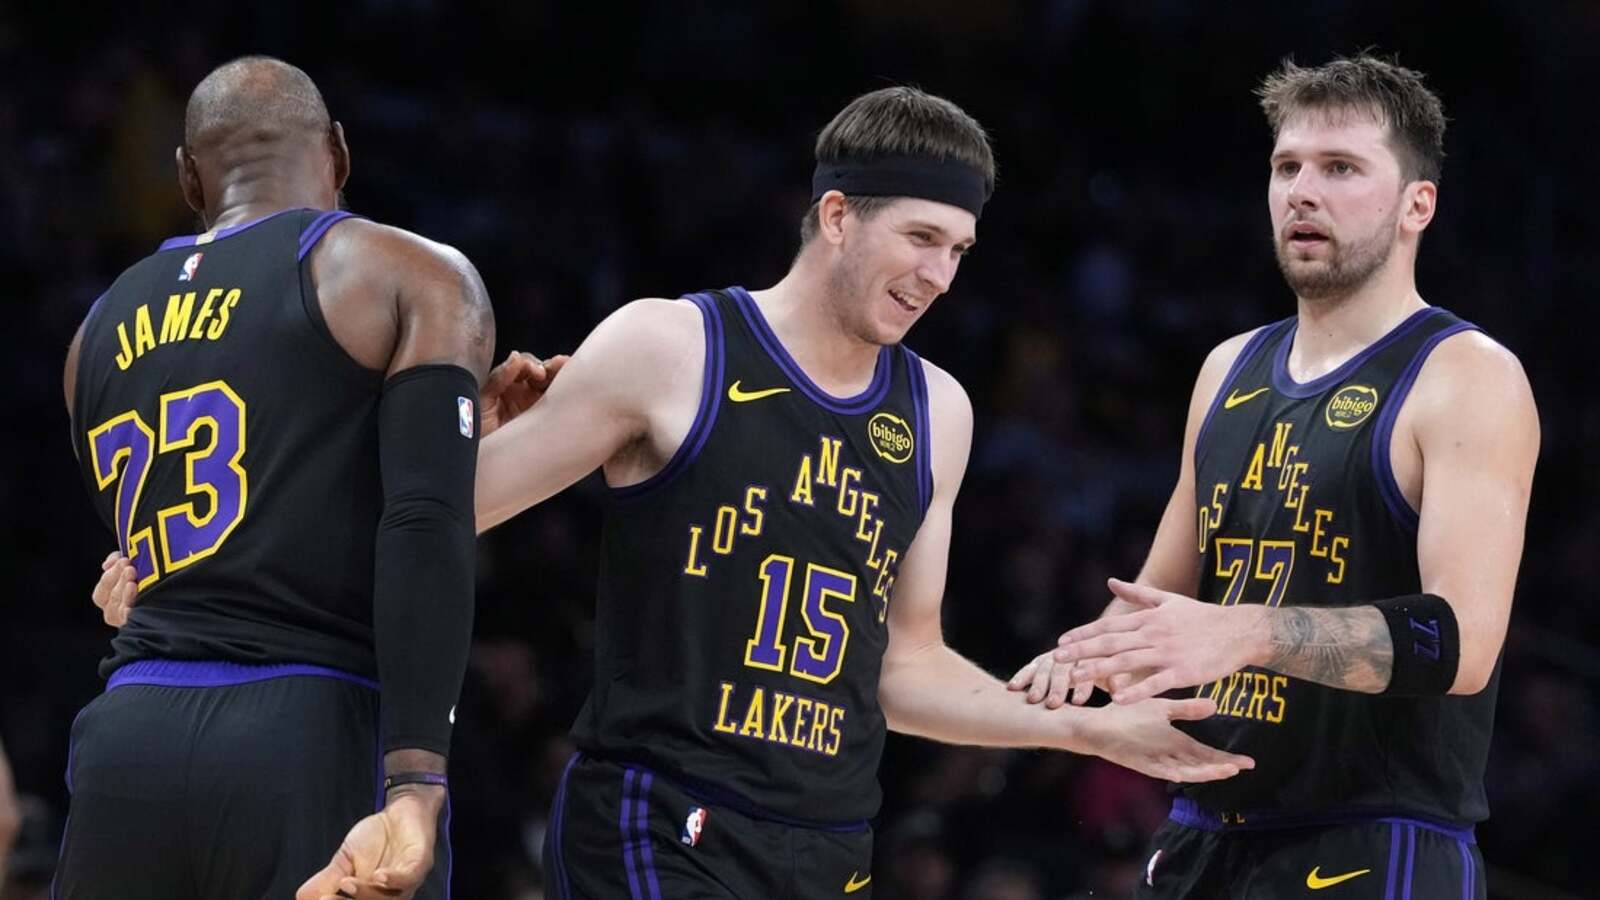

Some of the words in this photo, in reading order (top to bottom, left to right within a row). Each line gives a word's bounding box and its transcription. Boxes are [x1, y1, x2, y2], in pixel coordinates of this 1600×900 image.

[115, 288, 241, 371] JAMES
[872, 422, 911, 451] bibigo
[1331, 396, 1373, 417] bibigo
[88, 380, 248, 592] 23
[1199, 483, 1228, 553] OS
[1241, 423, 1349, 584] ANGELES
[684, 486, 767, 577] LOS
[791, 436, 898, 623] ANGELES
[1215, 537, 1296, 608] 77
[743, 554, 857, 685] 15
[713, 683, 846, 757] LAKERS
[1195, 672, 1288, 724] AKERS
